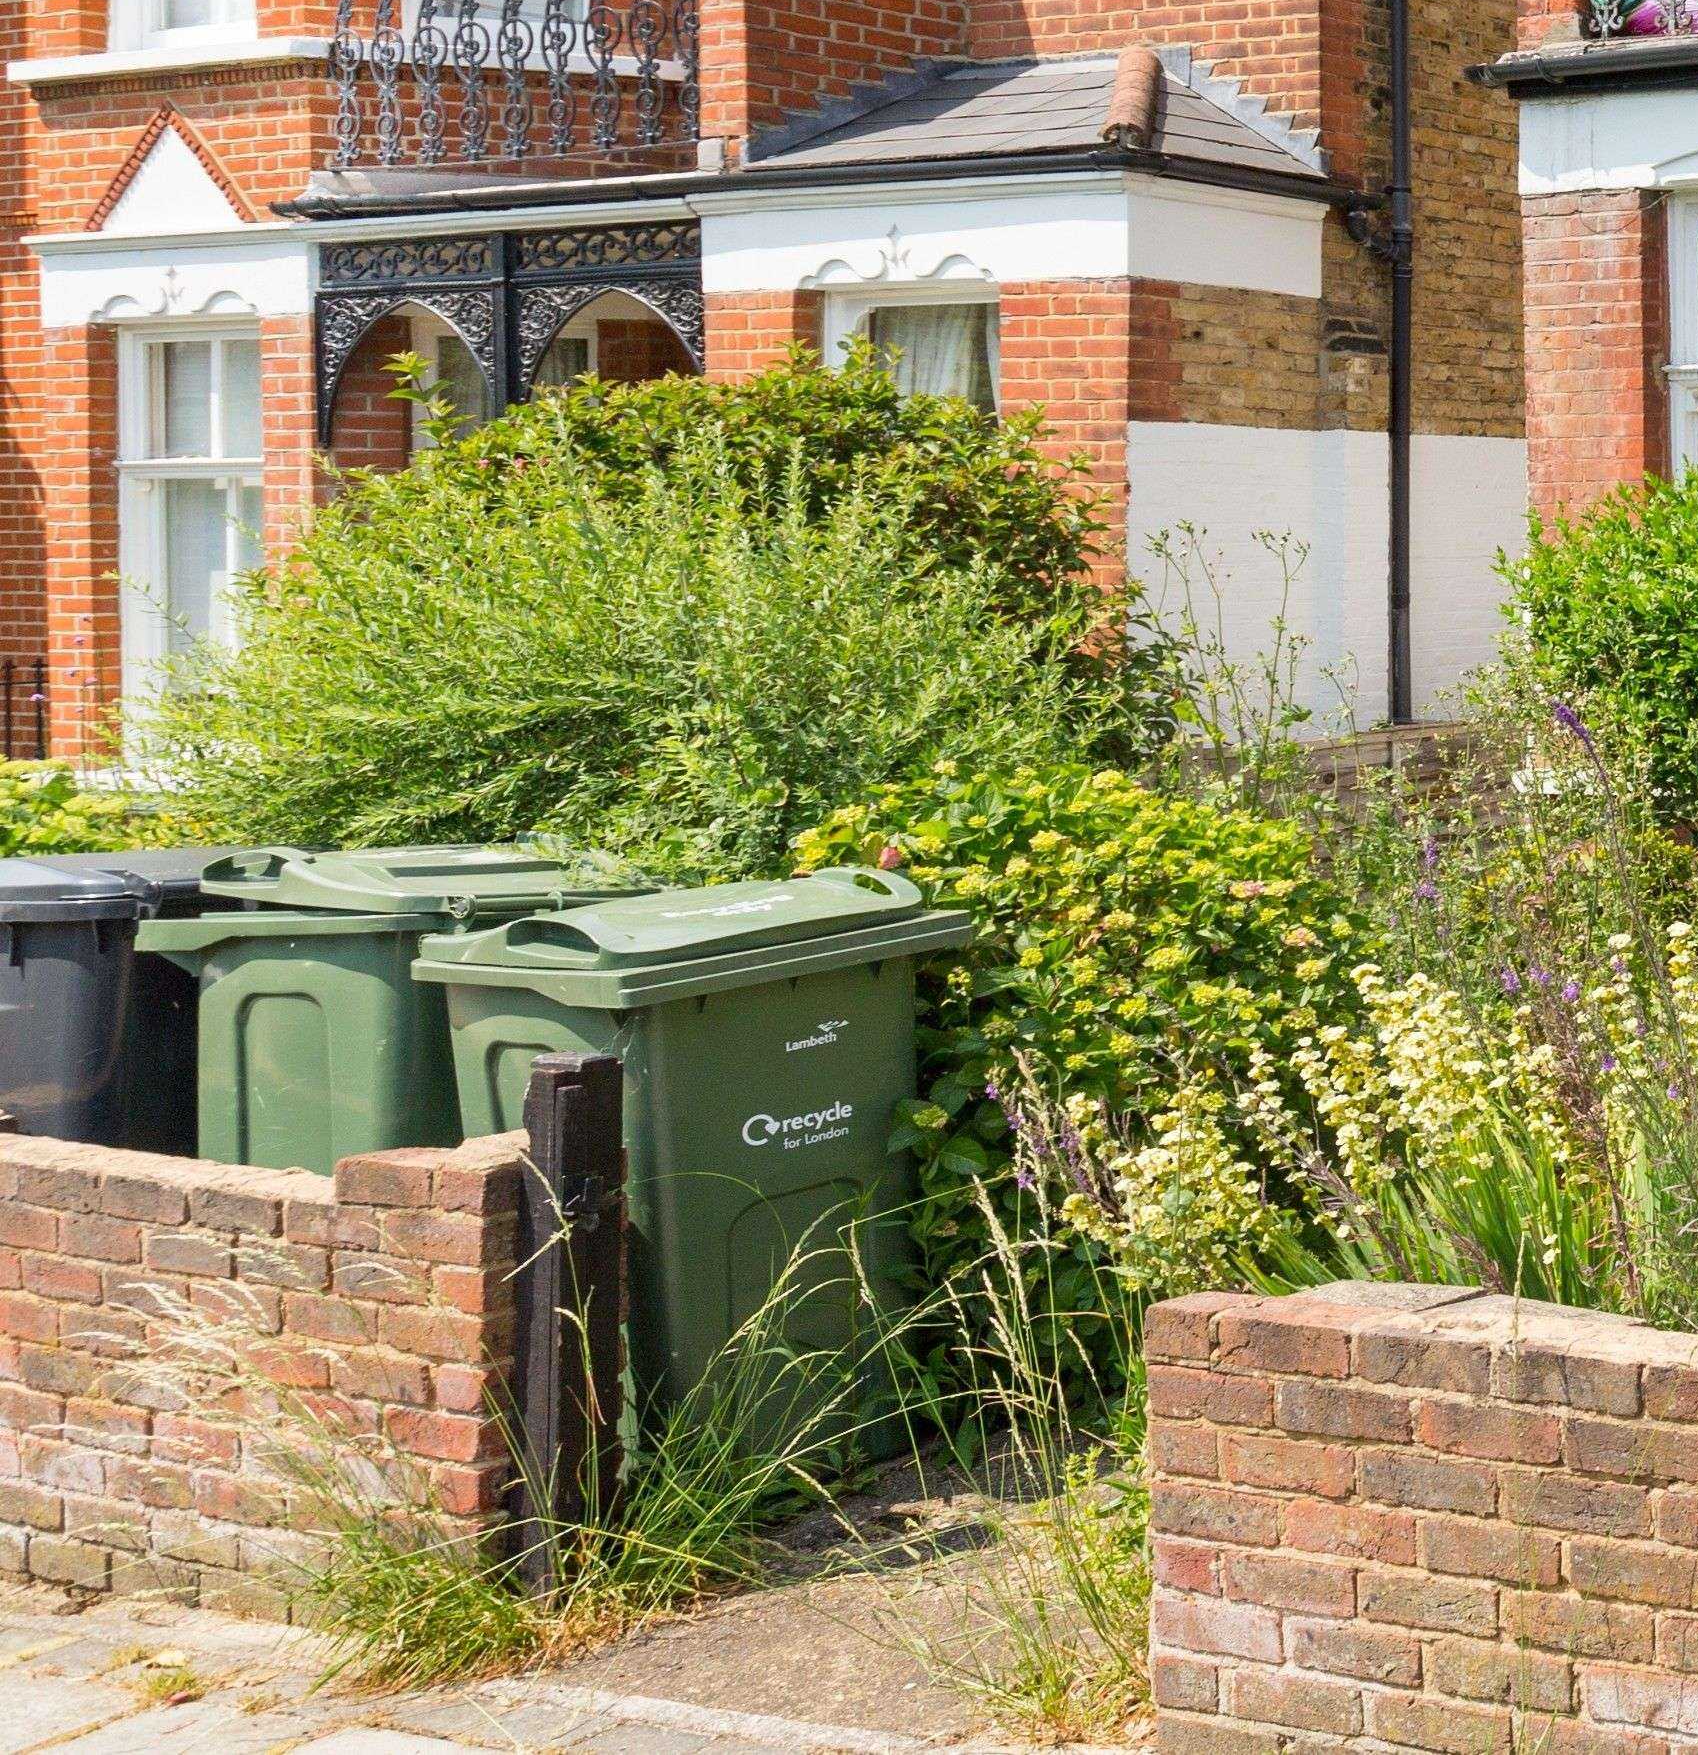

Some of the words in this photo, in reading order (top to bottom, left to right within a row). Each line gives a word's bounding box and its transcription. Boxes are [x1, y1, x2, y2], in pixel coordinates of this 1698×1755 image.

[785, 1031, 837, 1051] Lambeth
[782, 1101, 853, 1132] recycle
[783, 1138, 802, 1149] for
[804, 1127, 849, 1144] London
